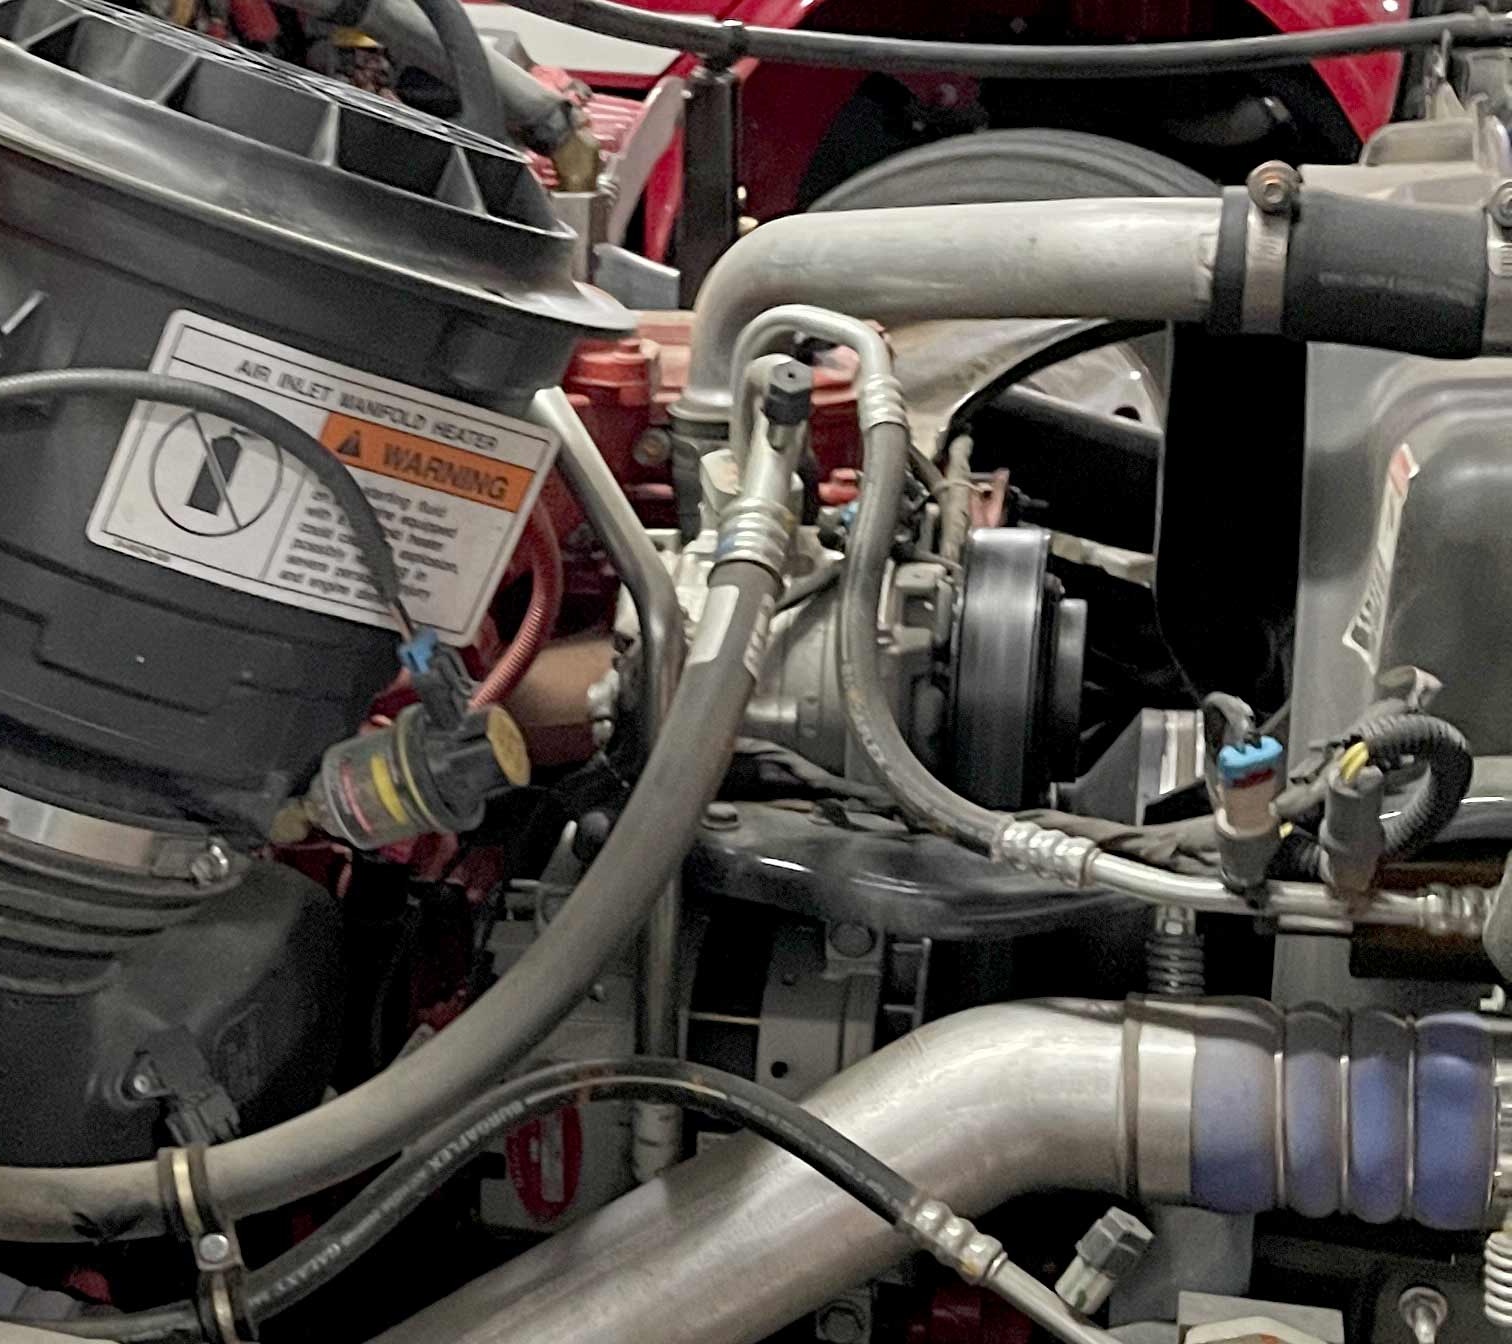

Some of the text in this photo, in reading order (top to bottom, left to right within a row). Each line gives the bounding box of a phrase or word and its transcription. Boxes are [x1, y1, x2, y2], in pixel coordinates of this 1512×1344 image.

[236, 359, 497, 452] AIR INLET MANIFOLD HEATER
[381, 443, 507, 499] WARNING
